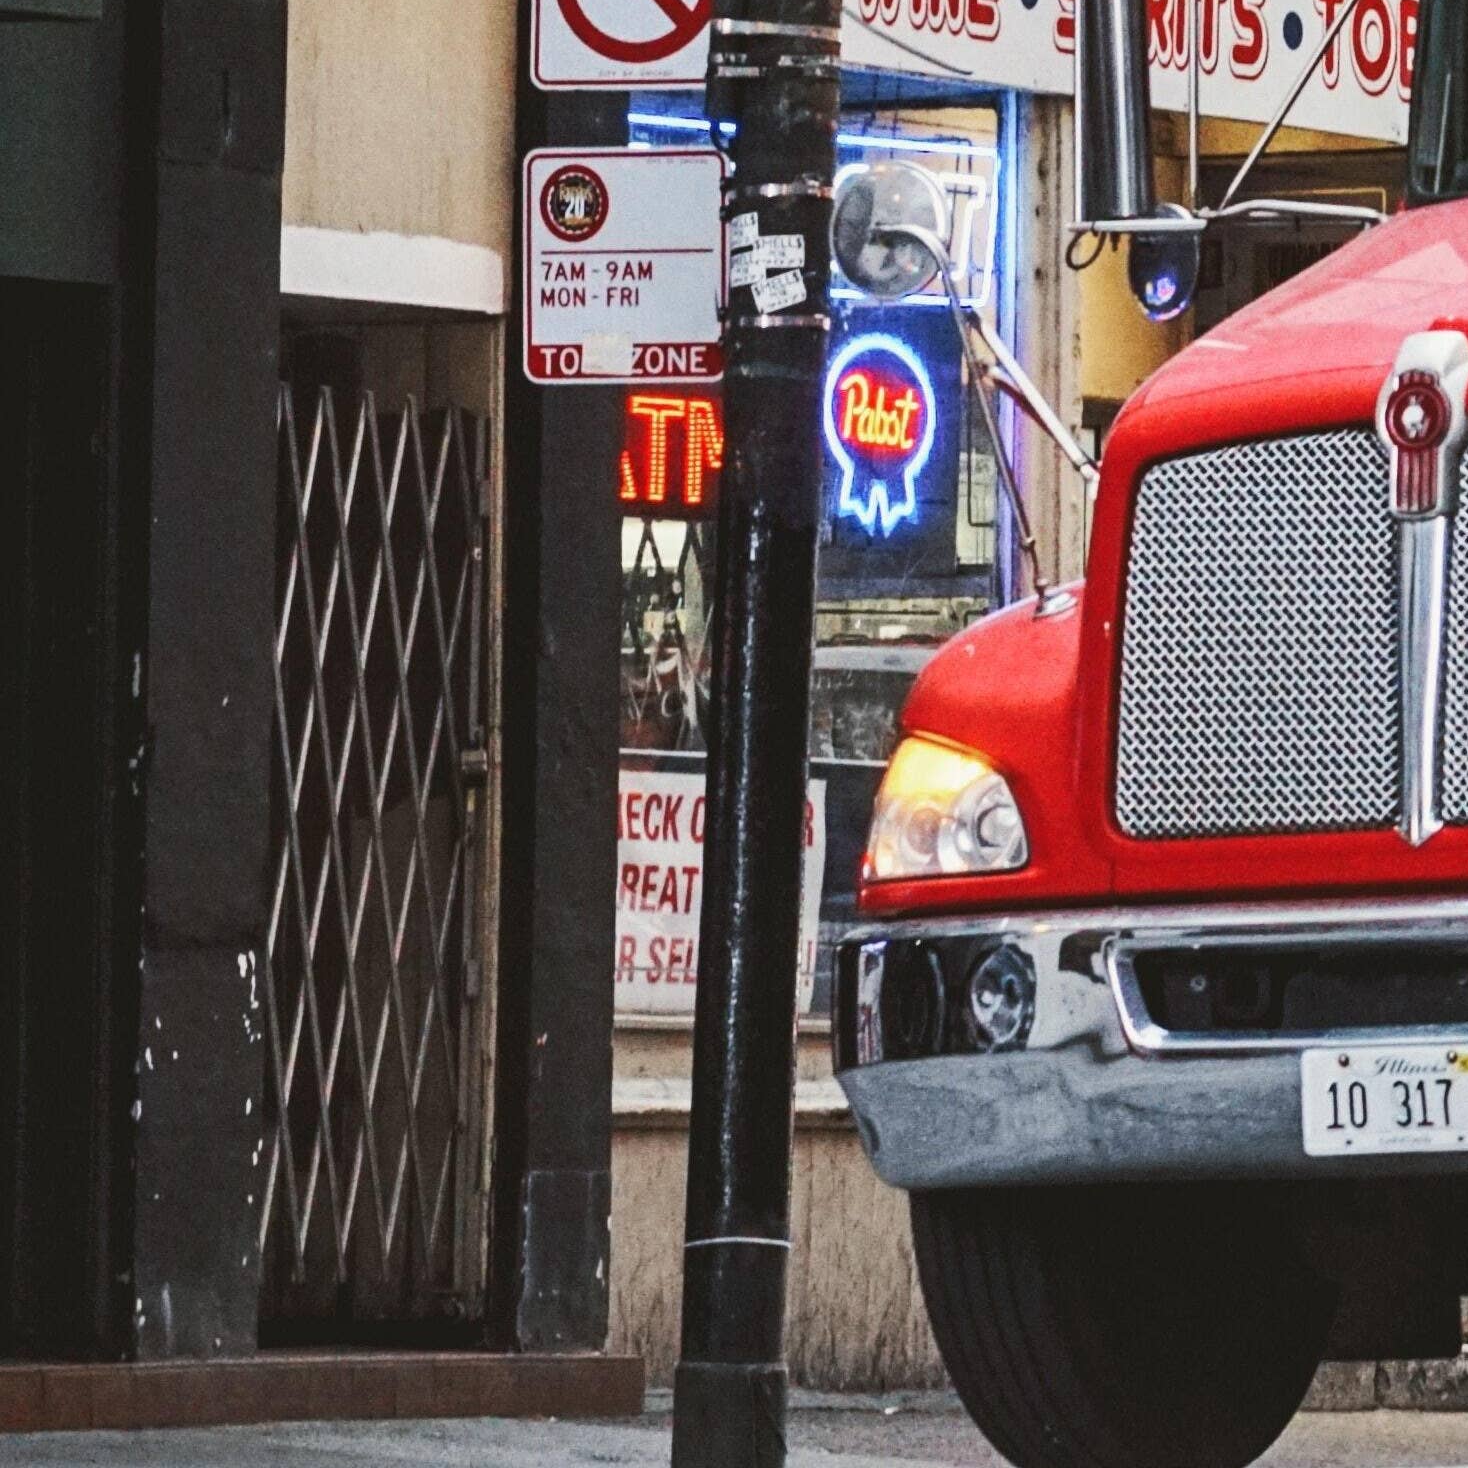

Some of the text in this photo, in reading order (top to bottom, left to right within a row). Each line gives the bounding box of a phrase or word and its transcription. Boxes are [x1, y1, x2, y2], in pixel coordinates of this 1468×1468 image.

[541, 261, 587, 281] 7AM
[607, 261, 654, 281] 9AM
[540, 288, 587, 308] MON
[606, 287, 640, 308] FRI
[540, 345, 708, 375] TO ZONE
[841, 373, 920, 450] Pabst
[618, 792, 684, 843] ECK
[1326, 1080, 1368, 1130] 10
[1392, 1078, 1453, 1128] 317
